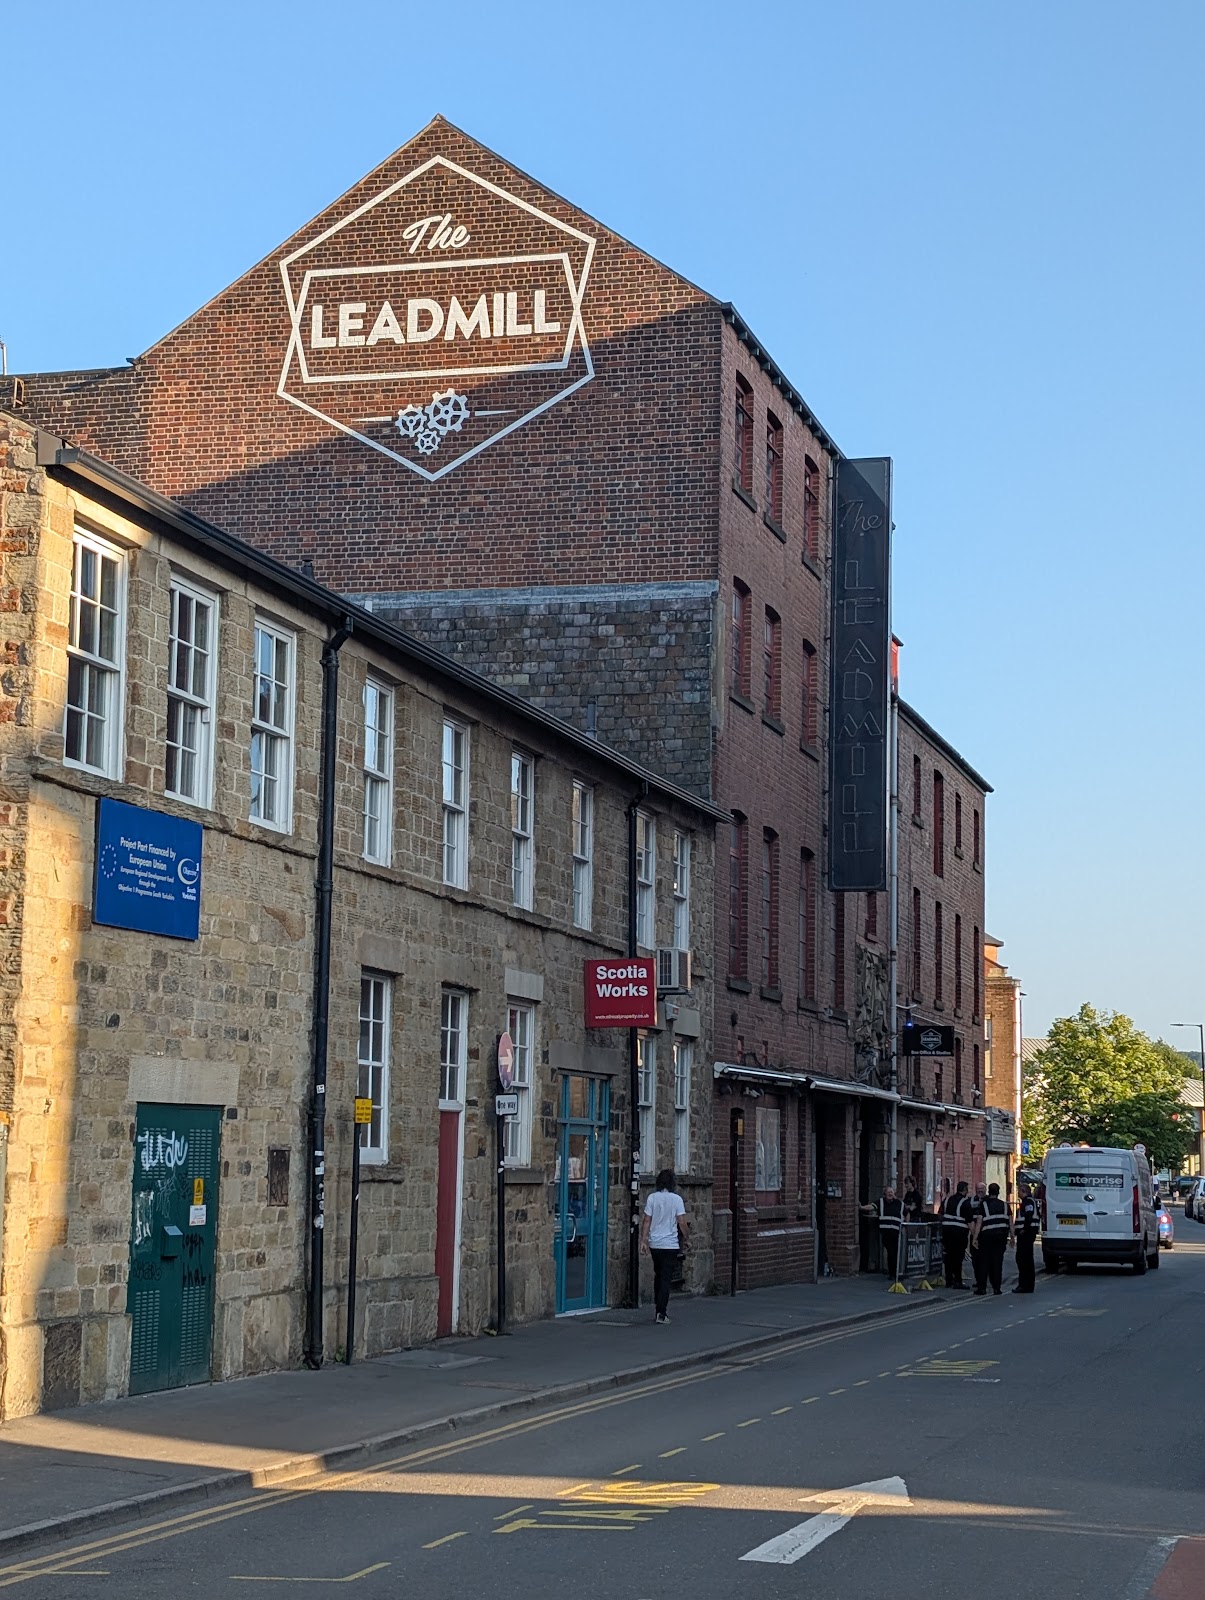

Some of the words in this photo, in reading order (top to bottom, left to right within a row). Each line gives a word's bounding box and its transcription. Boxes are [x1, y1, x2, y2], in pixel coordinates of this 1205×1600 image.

[402, 213, 471, 254] The
[311, 289, 561, 349] LEADMILL
[838, 499, 883, 533] The
[837, 560, 883, 853] LEADMILL
[120, 836, 137, 851] Project
[137, 841, 148, 852] Part
[148, 843, 169, 858] Financed
[169, 847, 177, 861] by
[129, 853, 152, 868] European
[152, 859, 167, 871] Union
[596, 965, 647, 980] Scotia
[595, 983, 649, 998] Works
[1058, 1175, 1123, 1186] enterprise
[492, 1481, 721, 1534] TAXIS
